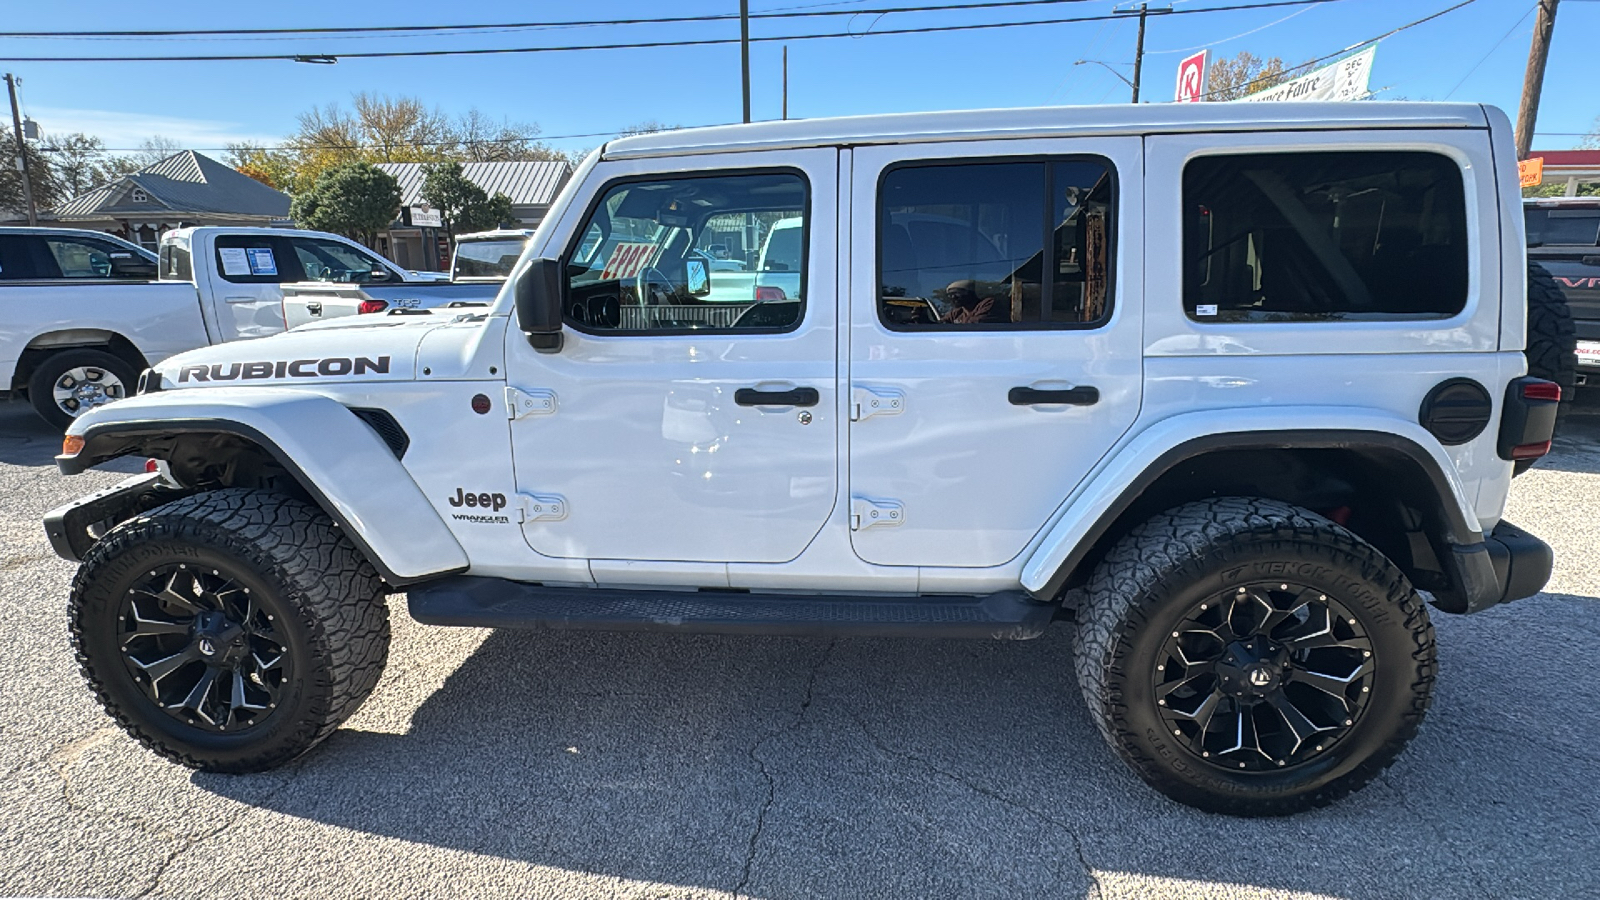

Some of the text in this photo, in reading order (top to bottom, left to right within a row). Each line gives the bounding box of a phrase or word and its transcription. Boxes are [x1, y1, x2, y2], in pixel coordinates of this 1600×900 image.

[1184, 71, 1196, 97] K
[1285, 76, 1320, 101] Faire
[178, 356, 390, 383] RUBICON
[448, 488, 507, 512] Jeep
